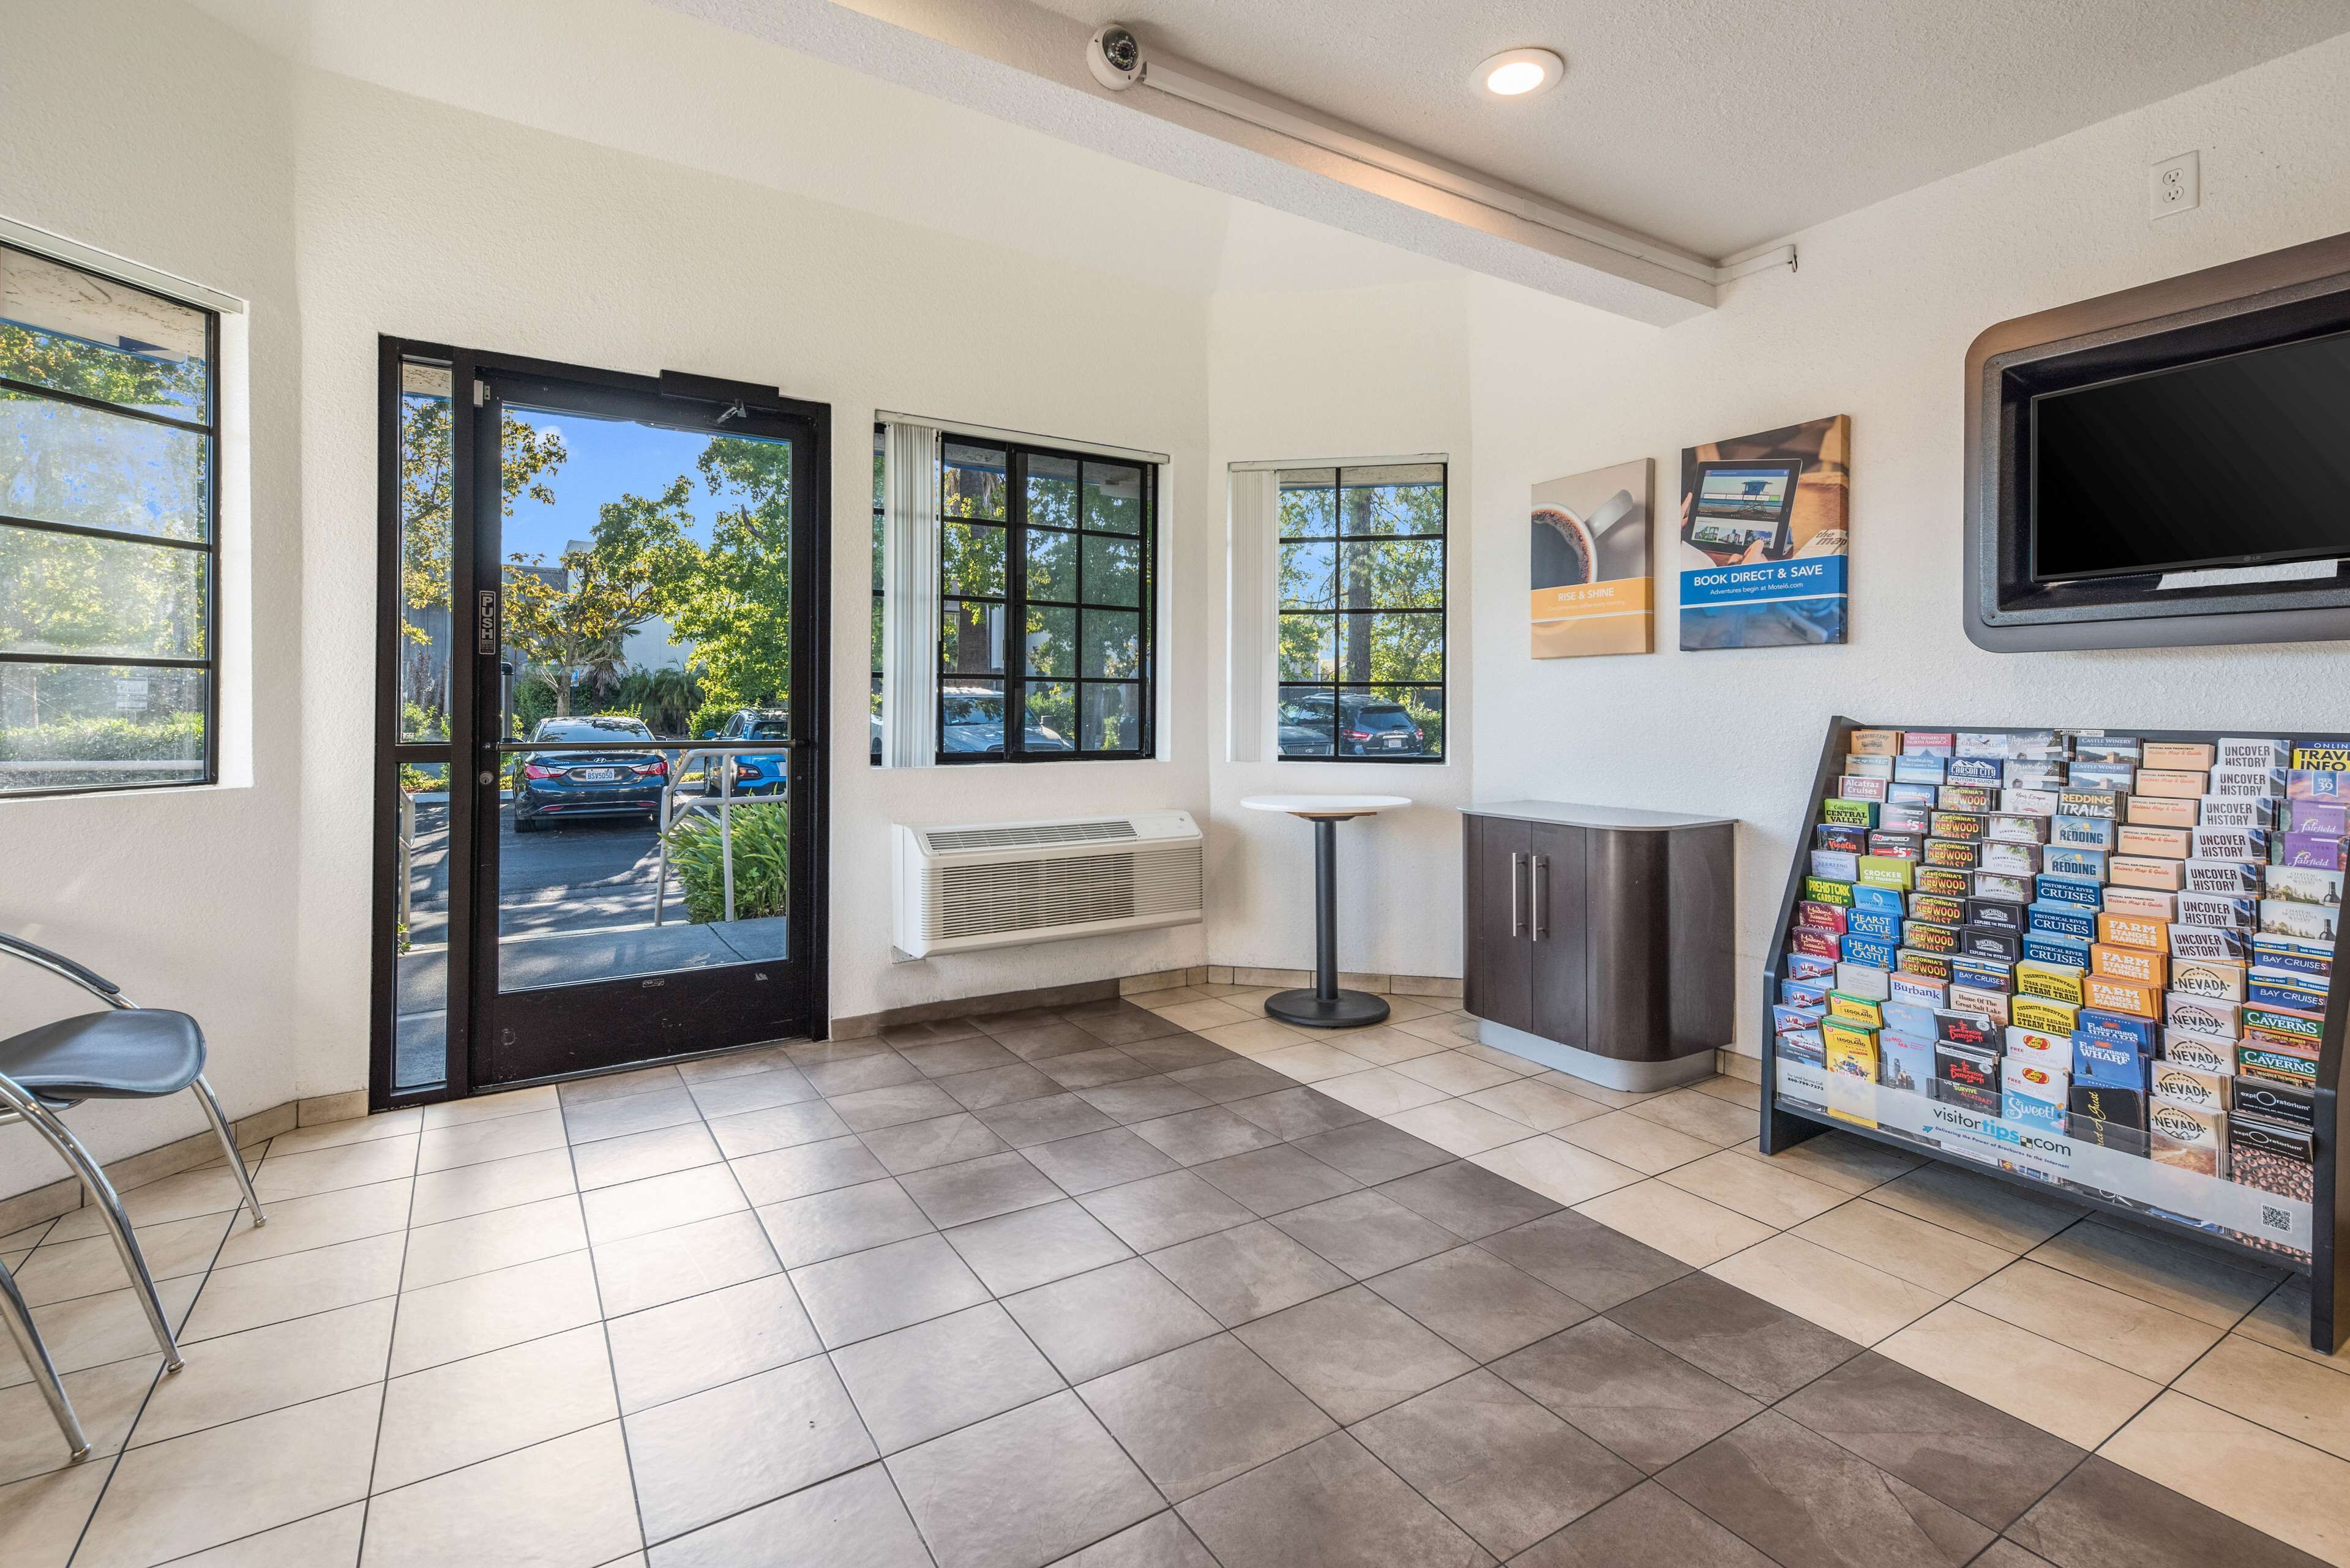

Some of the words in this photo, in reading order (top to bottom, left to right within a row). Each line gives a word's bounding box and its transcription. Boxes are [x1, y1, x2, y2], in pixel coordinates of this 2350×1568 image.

[1816, 537, 1847, 547] map
[1694, 574, 1727, 586] BOOK
[1731, 570, 1773, 583] DIRECT
[1778, 569, 1786, 578] &
[1791, 565, 1823, 576] SAVE
[1558, 592, 1576, 601] RISE
[1588, 588, 1614, 598] SHINE
[481, 596, 493, 639] PUSH
[2010, 734, 2054, 744] Agriventure
[2225, 746, 2270, 756] UNCOVER
[2226, 758, 2266, 767] HISTORY
[2300, 761, 2346, 771] INFO
[1846, 779, 1879, 788] Alcatraz
[2220, 774, 2265, 785] UNCOVER
[2221, 786, 2262, 796] HISTORY
[2318, 783, 2333, 791] 39
[1942, 795, 1986, 806] REDWOOD
[2062, 794, 2114, 804] REDDING
[2061, 803, 2113, 817] TRAILS
[2206, 804, 2252, 814] UNCOVER
[2060, 830, 2103, 844] REDDING
[1828, 840, 1857, 850] Visalia
[1864, 869, 1902, 878] CROCKER
[2041, 882, 2075, 890] HISTORICAL
[1817, 894, 1842, 905] GARDENS
[2040, 887, 2095, 903] CRUISES
[1808, 906, 1832, 916] Madame
[1980, 908, 2008, 918] WINCHESTER
[1809, 913, 1833, 922] Tussauds
[1850, 913, 1891, 925] HEARST
[2035, 913, 2067, 922] HISTORICAL
[1854, 922, 1891, 933] CASTLE
[2034, 919, 2089, 935] CRUISES
[2109, 920, 2156, 934] FARM
[2111, 930, 2147, 939] STANDS
[2110, 935, 2157, 946] MARKETS
[1849, 939, 1890, 955] HEARST
[1852, 949, 1889, 963] CASTLE
[2102, 952, 2150, 968] FARM
[2262, 955, 2282, 963] BAY
[2285, 958, 2326, 970] CRUISES
[2103, 966, 2149, 980] MARKETS
[1974, 974, 2004, 985] CRUISES
[2049, 975, 2076, 989] MOUNTAIN
[2178, 978, 2228, 991] NEVADA
[1893, 982, 1940, 999] Burbank
[2024, 985, 2051, 996] STEAM
[2053, 991, 2079, 1002] TRAIN
[2053, 986, 2078, 995] RAILROAD
[1844, 1009, 1873, 1018] LEGOLAND
[2018, 1018, 2045, 1029] STEAM
[2046, 1024, 2071, 1036] TRAIN
[2172, 1015, 2222, 1028] NEVADA
[2247, 1012, 2318, 1034] CAVERNS
[2087, 1022, 2138, 1037] Fisherman's
[1836, 1037, 1865, 1047] LEGOLAND
[2078, 1041, 2130, 1058] Fisherman's
[2080, 1048, 2130, 1065] WHARF
[2244, 1051, 2316, 1074] CAVERNS
[1954, 1086, 1977, 1094] SURVIVE
[2006, 1097, 2054, 1119] Sweet!
[1935, 1126, 1961, 1137] Delivering
[1972, 1137, 1989, 1146] Power
[1997, 1144, 2025, 1155] Brochures
[2045, 1159, 2069, 1169] Internet!
